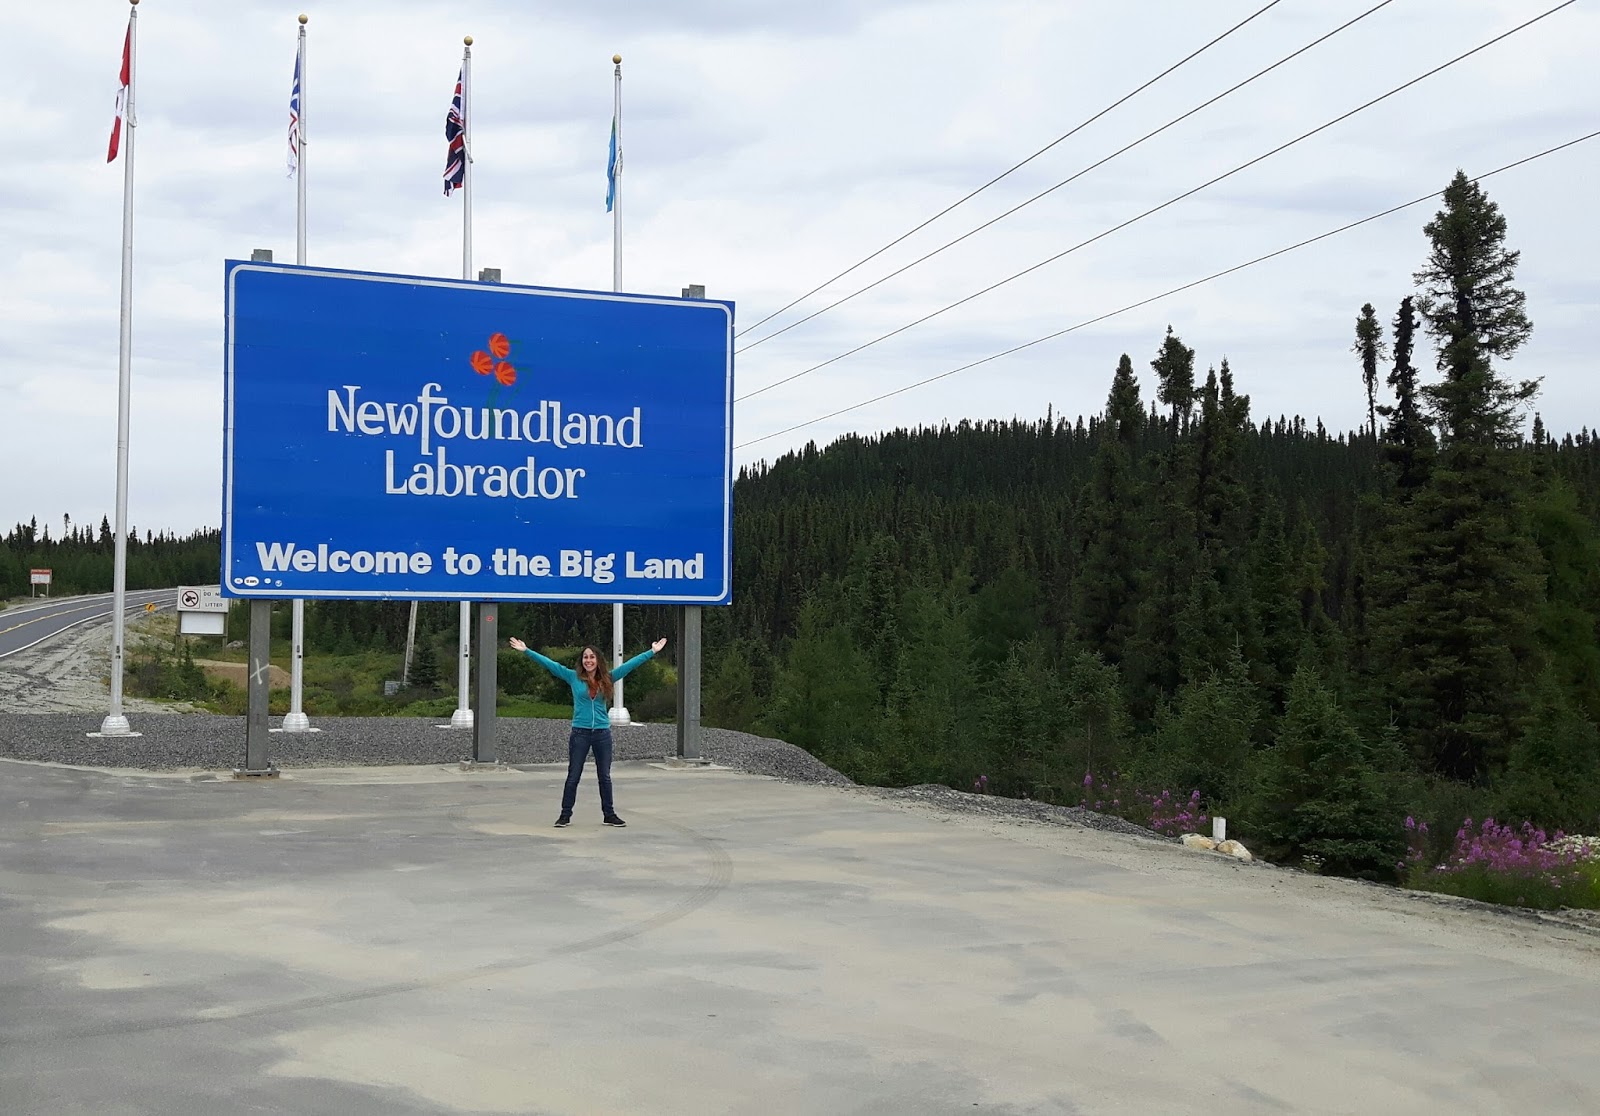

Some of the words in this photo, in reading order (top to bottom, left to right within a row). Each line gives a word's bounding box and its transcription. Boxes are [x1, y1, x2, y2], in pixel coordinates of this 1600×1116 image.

[327, 383, 644, 455] Newfoundland
[386, 446, 586, 499] Labrador
[256, 542, 432, 574] Welcome
[443, 548, 482, 576] to
[492, 548, 550, 577] the
[560, 550, 615, 584] Big
[626, 552, 704, 580] Land
